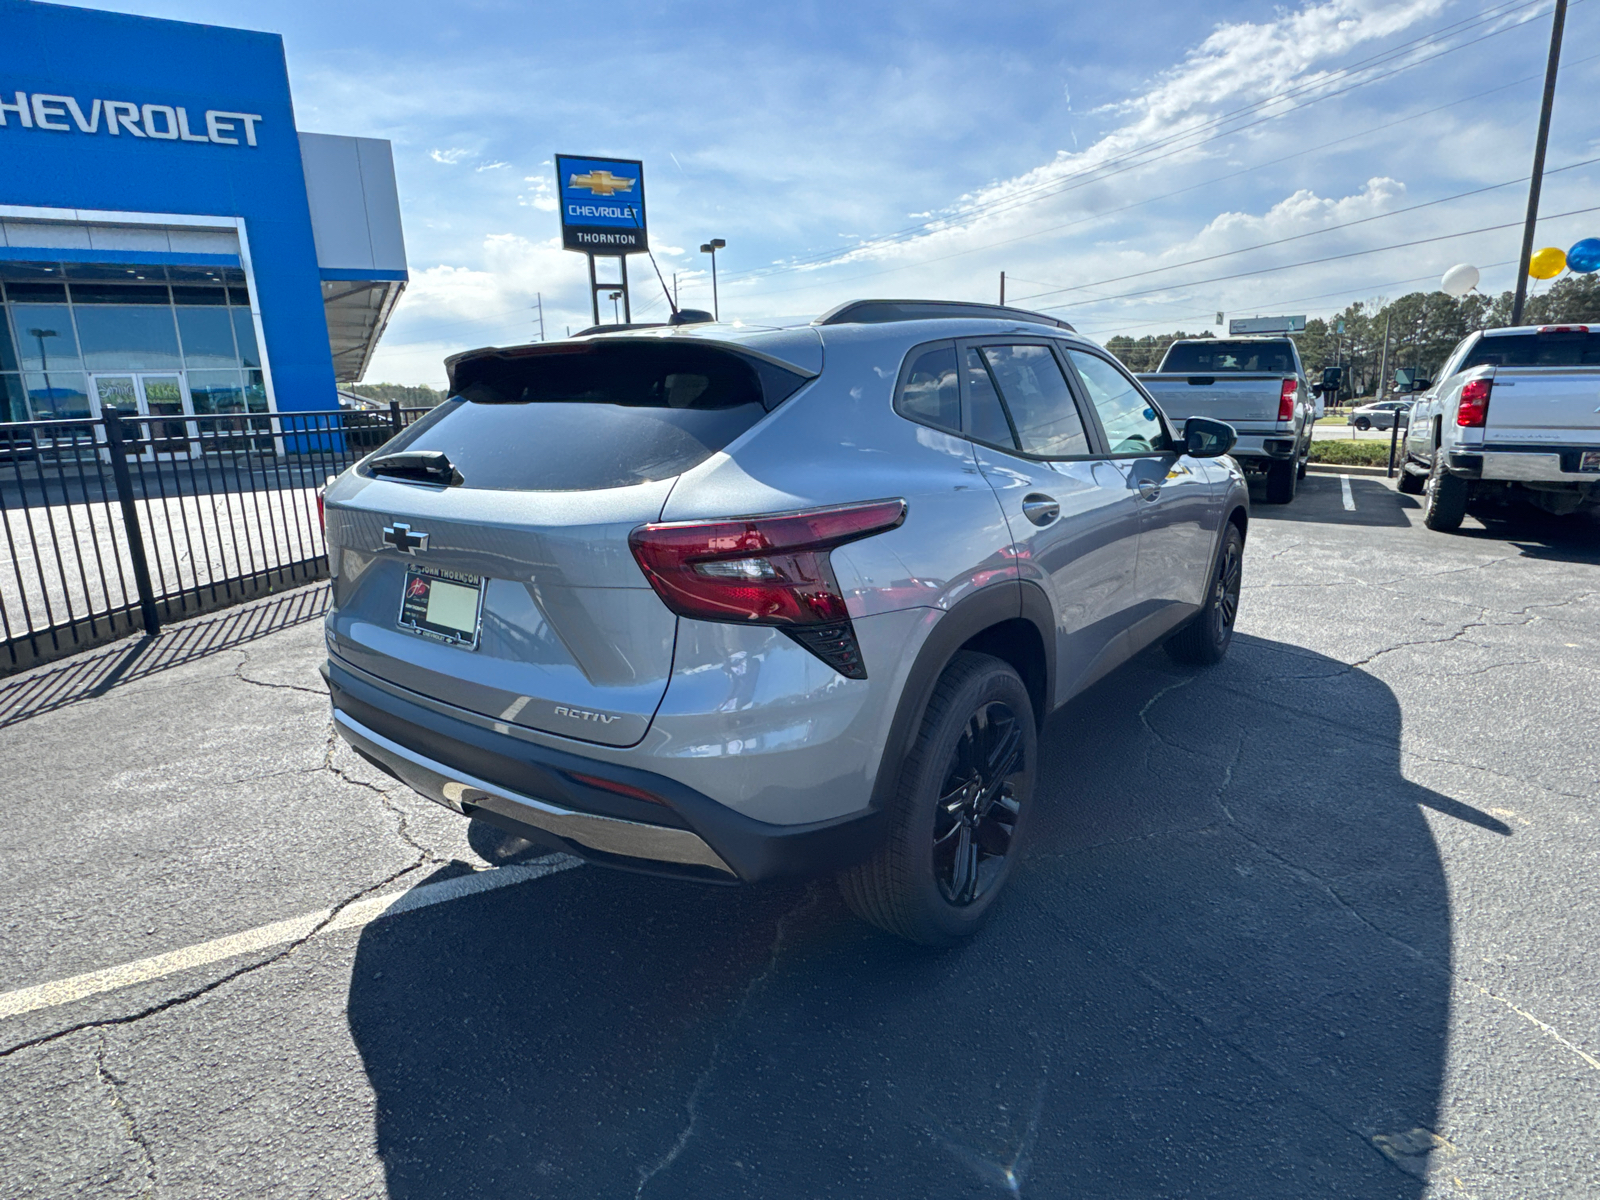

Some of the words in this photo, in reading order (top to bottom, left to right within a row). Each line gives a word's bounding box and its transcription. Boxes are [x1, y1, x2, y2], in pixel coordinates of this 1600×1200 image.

[0, 91, 262, 146] HEVROLET
[568, 205, 638, 218] CHEVROLET
[577, 232, 635, 245] THORNTON
[421, 566, 440, 576] JOHN
[422, 631, 445, 640] CHEVROLET
[554, 706, 622, 724] ACTIV
